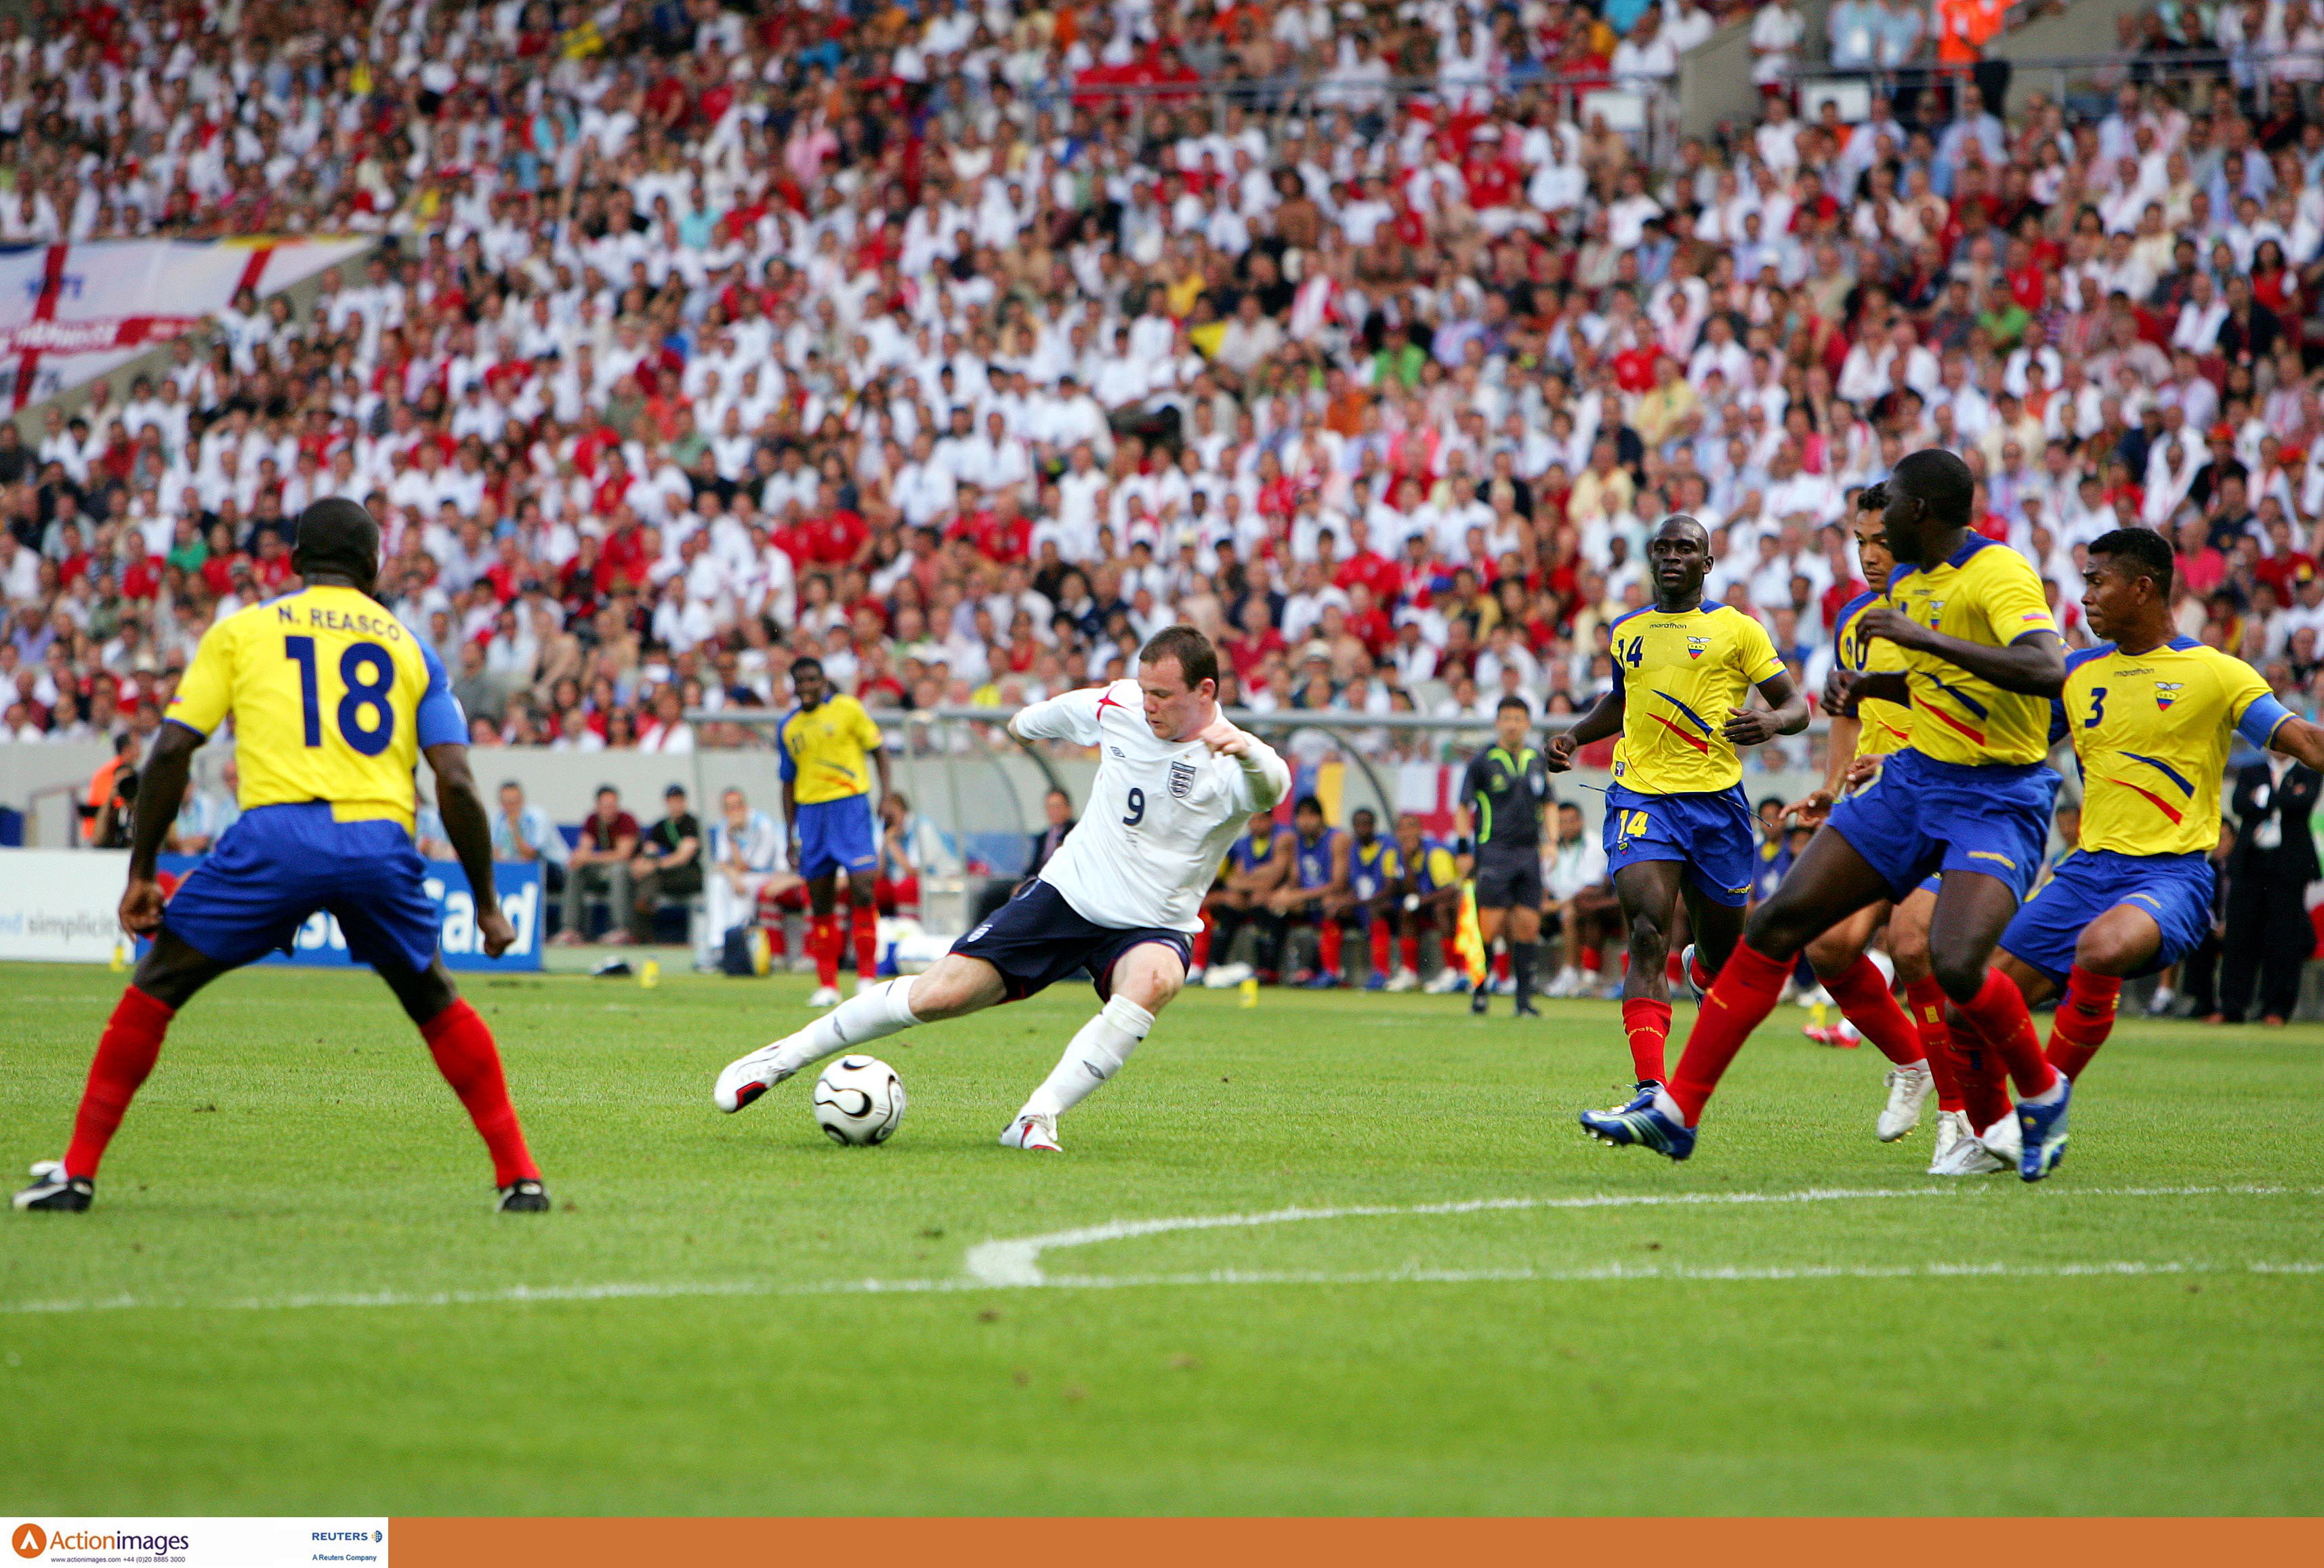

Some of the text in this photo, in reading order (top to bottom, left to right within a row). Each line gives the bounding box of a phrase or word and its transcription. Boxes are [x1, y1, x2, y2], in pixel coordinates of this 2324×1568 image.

[278, 606, 401, 642] N. REASCO
[1618, 635, 1644, 669] 14
[2114, 667, 2155, 677] marathon
[285, 636, 394, 756] 18
[2085, 687, 2108, 728] 3
[1122, 787, 1144, 825] 9
[1618, 810, 1649, 840] 14
[0, 908, 119, 943] nd simplicit
